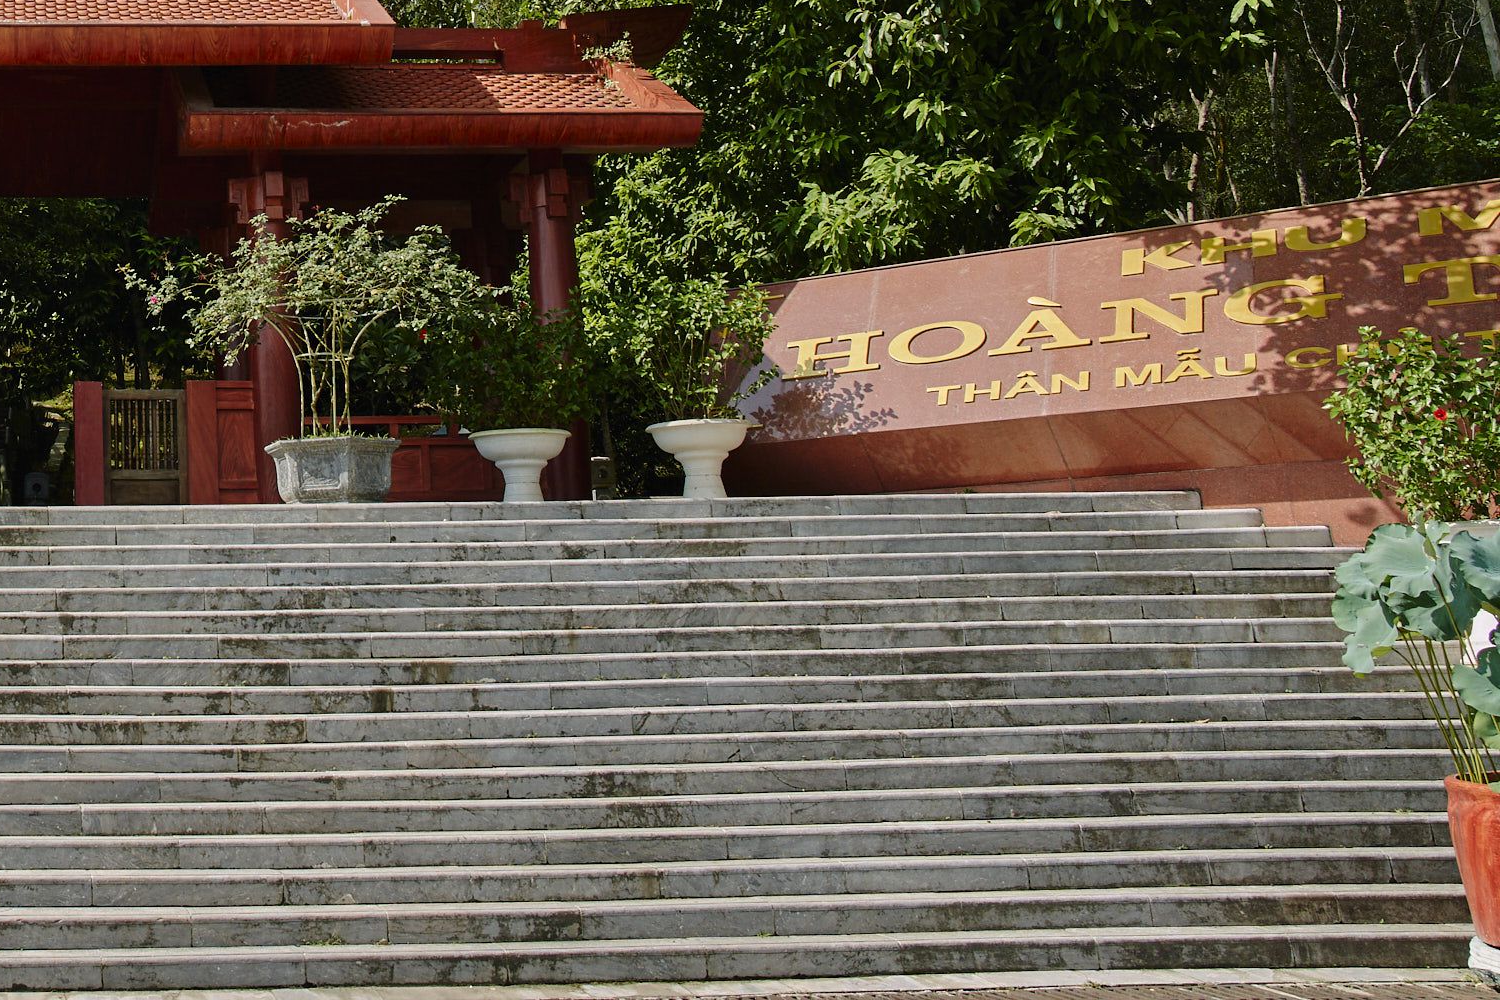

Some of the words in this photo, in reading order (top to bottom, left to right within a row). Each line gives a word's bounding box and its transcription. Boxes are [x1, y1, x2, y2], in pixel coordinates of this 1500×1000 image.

[1121, 217, 1366, 276] KHU
[782, 274, 1344, 380] HOÀNG
[927, 370, 1091, 406] THÂN
[1115, 347, 1257, 388] MẪU
